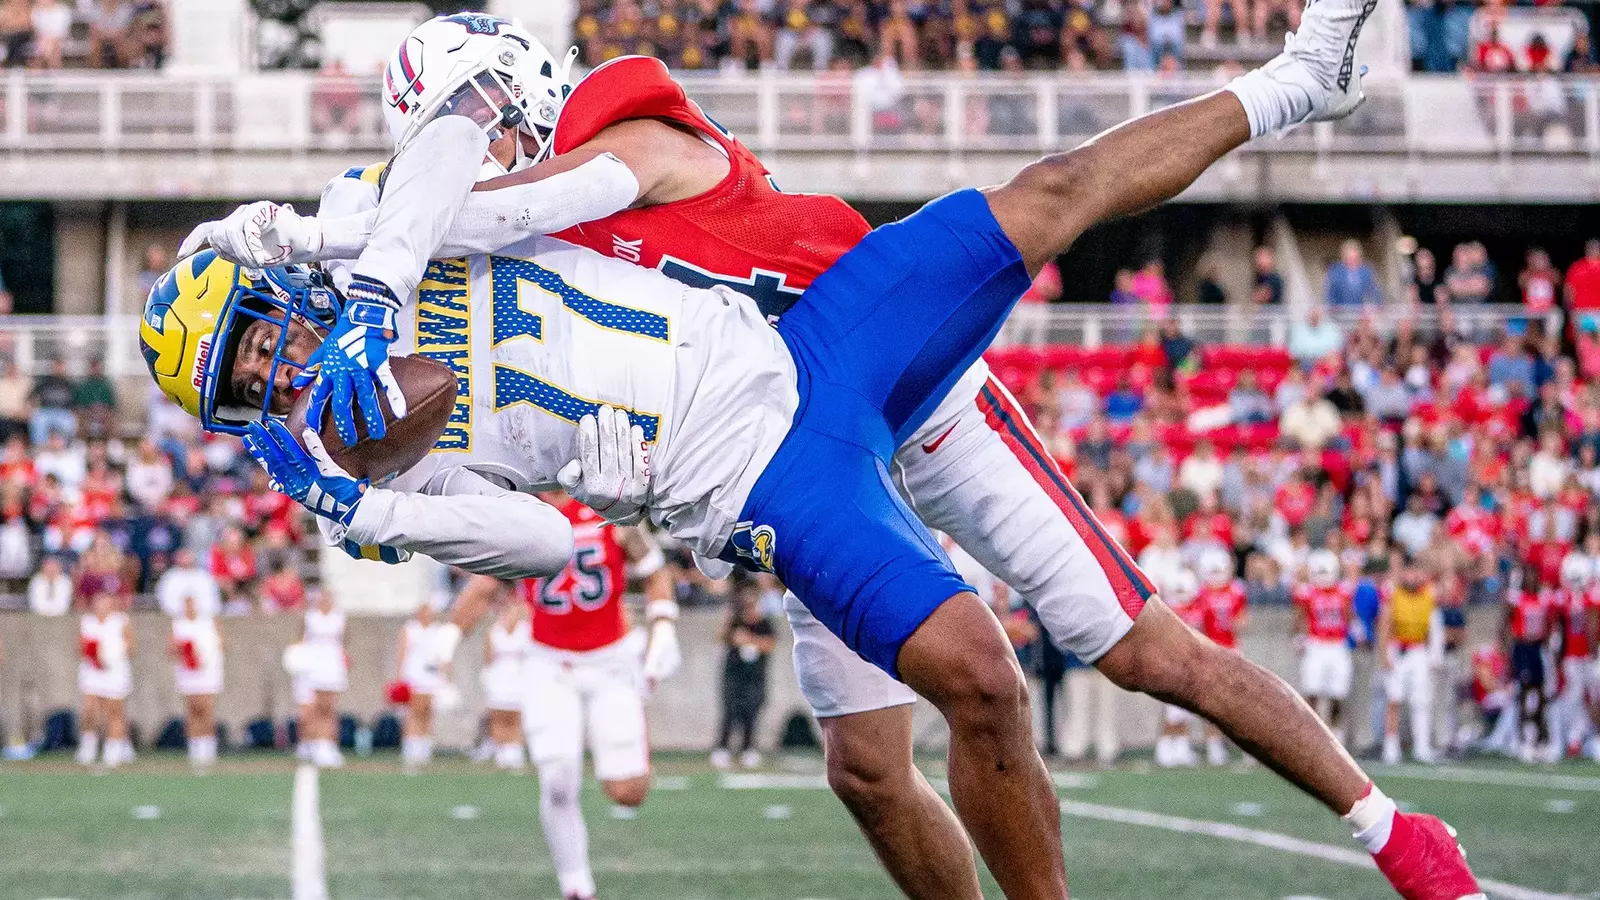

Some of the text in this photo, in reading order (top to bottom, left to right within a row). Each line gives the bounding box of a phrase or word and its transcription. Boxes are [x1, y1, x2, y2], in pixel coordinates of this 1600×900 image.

[193, 340, 211, 388] Riddell
[486, 254, 672, 446] 17
[531, 541, 614, 615] 25
